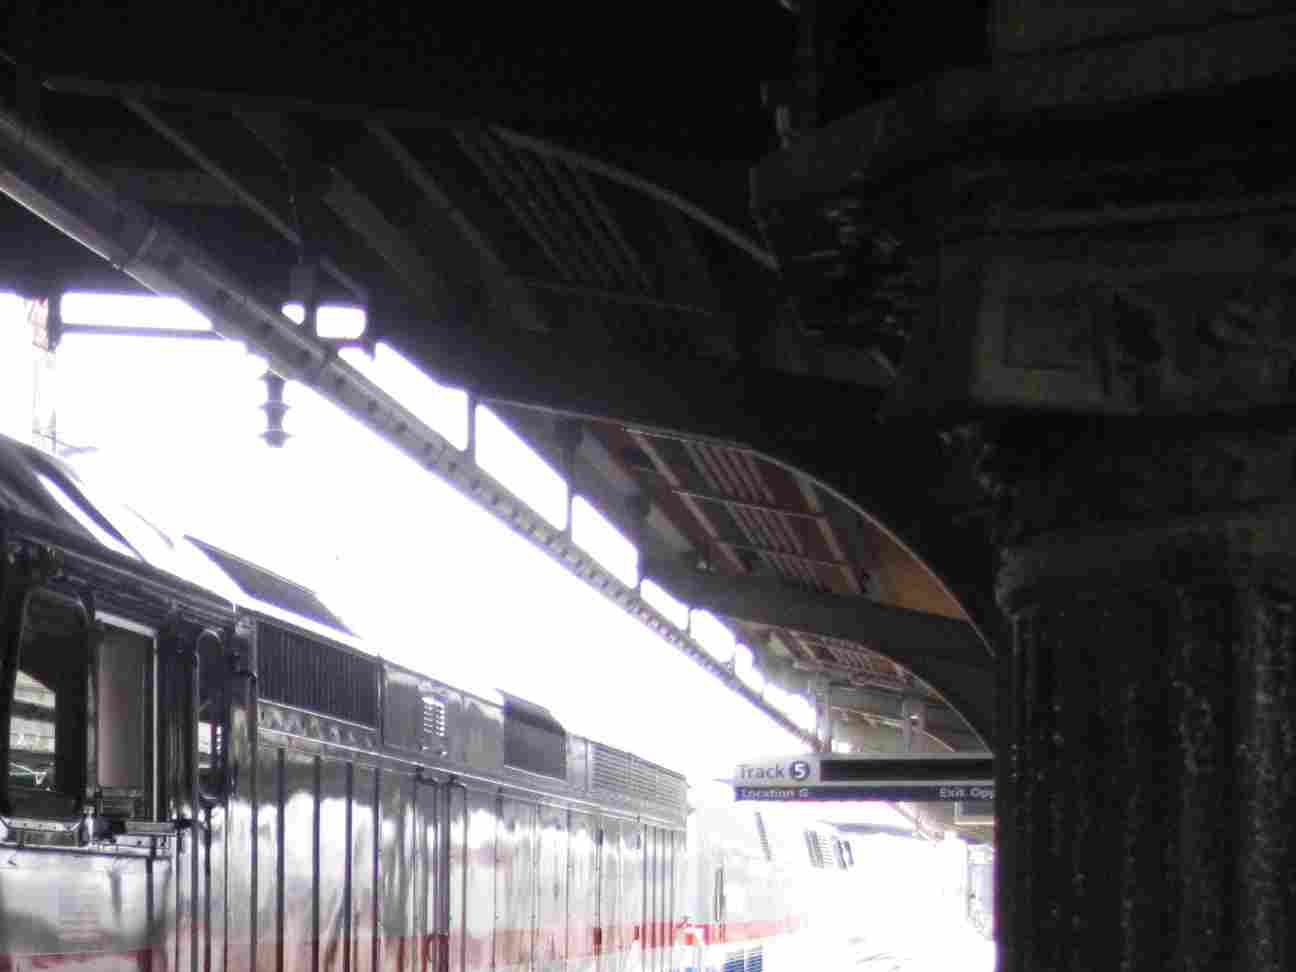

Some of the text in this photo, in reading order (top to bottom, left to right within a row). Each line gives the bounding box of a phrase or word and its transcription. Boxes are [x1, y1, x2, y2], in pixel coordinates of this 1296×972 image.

[736, 761, 808, 779] Track 5
[740, 787, 794, 799] Location
